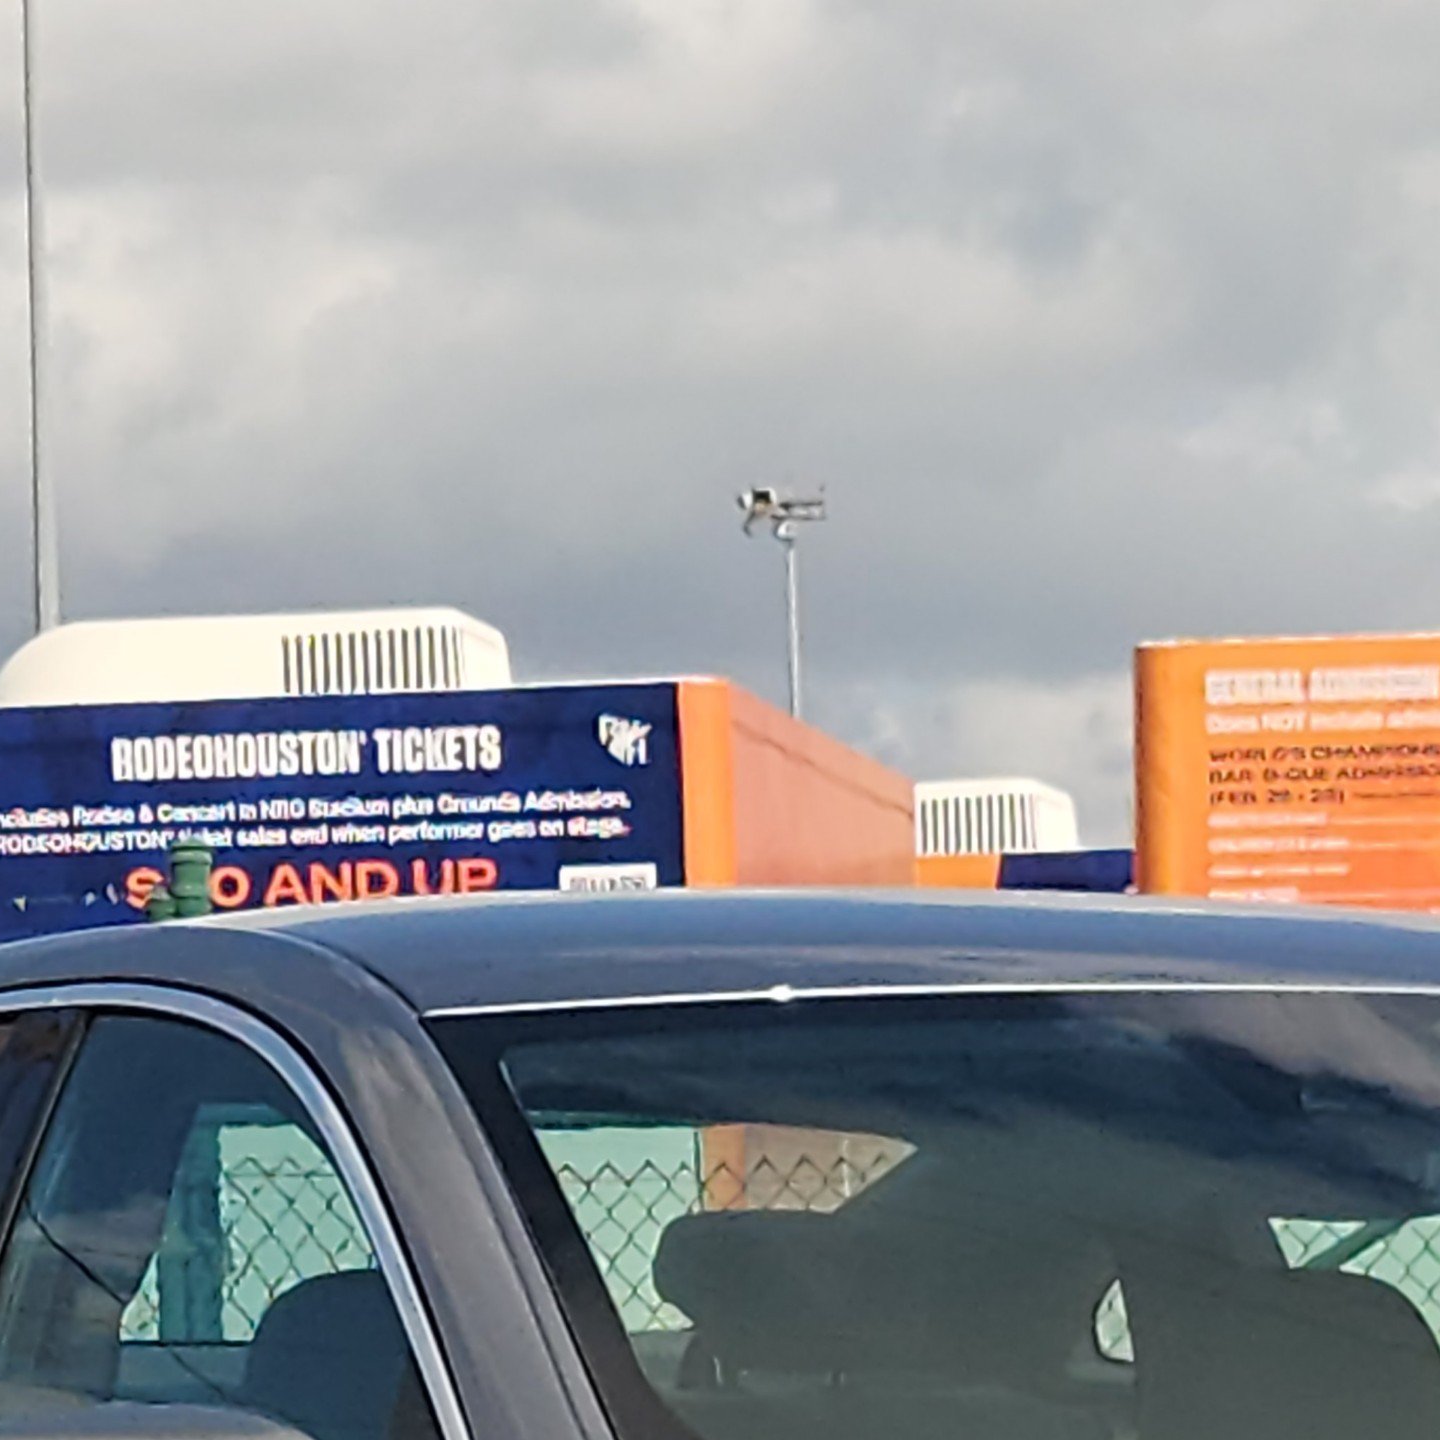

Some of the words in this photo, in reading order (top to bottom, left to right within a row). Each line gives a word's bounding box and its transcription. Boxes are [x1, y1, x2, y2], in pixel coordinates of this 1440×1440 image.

[374, 725, 502, 775] TICKETS
[125, 864, 252, 911] $0
[263, 858, 399, 906] AND
[412, 857, 499, 896] UP
